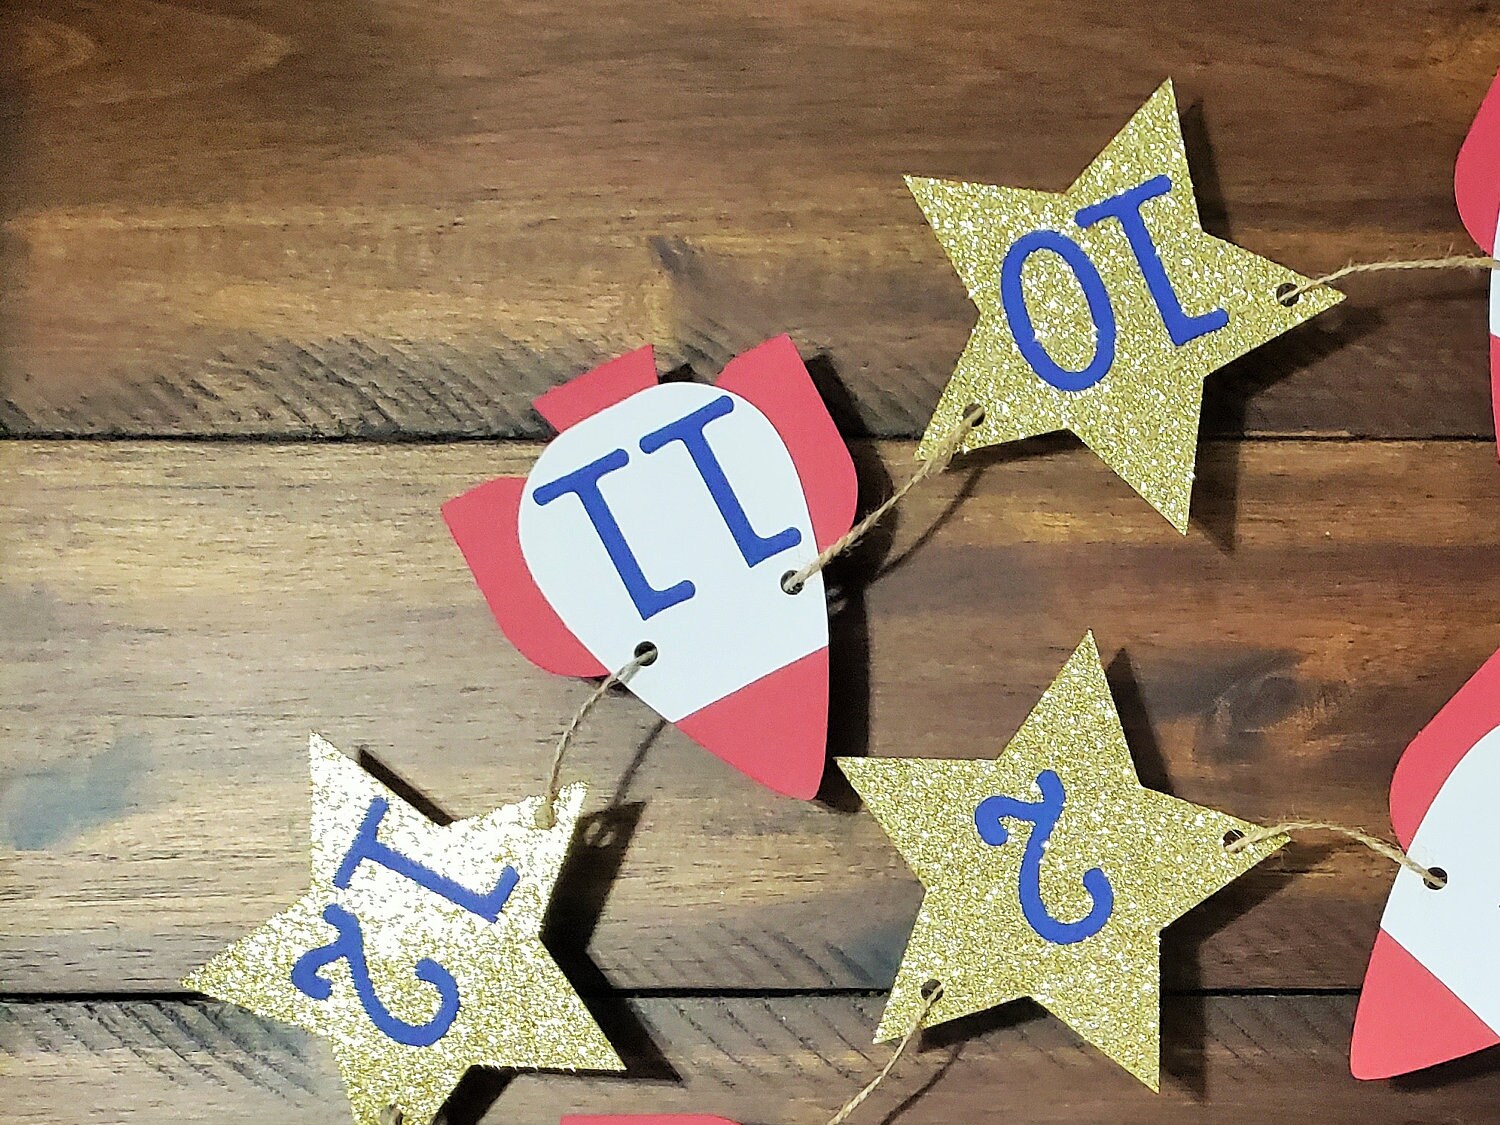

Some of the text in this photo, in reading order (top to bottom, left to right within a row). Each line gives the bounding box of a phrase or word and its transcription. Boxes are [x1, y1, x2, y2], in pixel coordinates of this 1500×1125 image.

[1001, 175, 1228, 391] 10
[533, 396, 801, 620] 11
[292, 800, 517, 1047] 12
[975, 771, 1112, 944] 2
